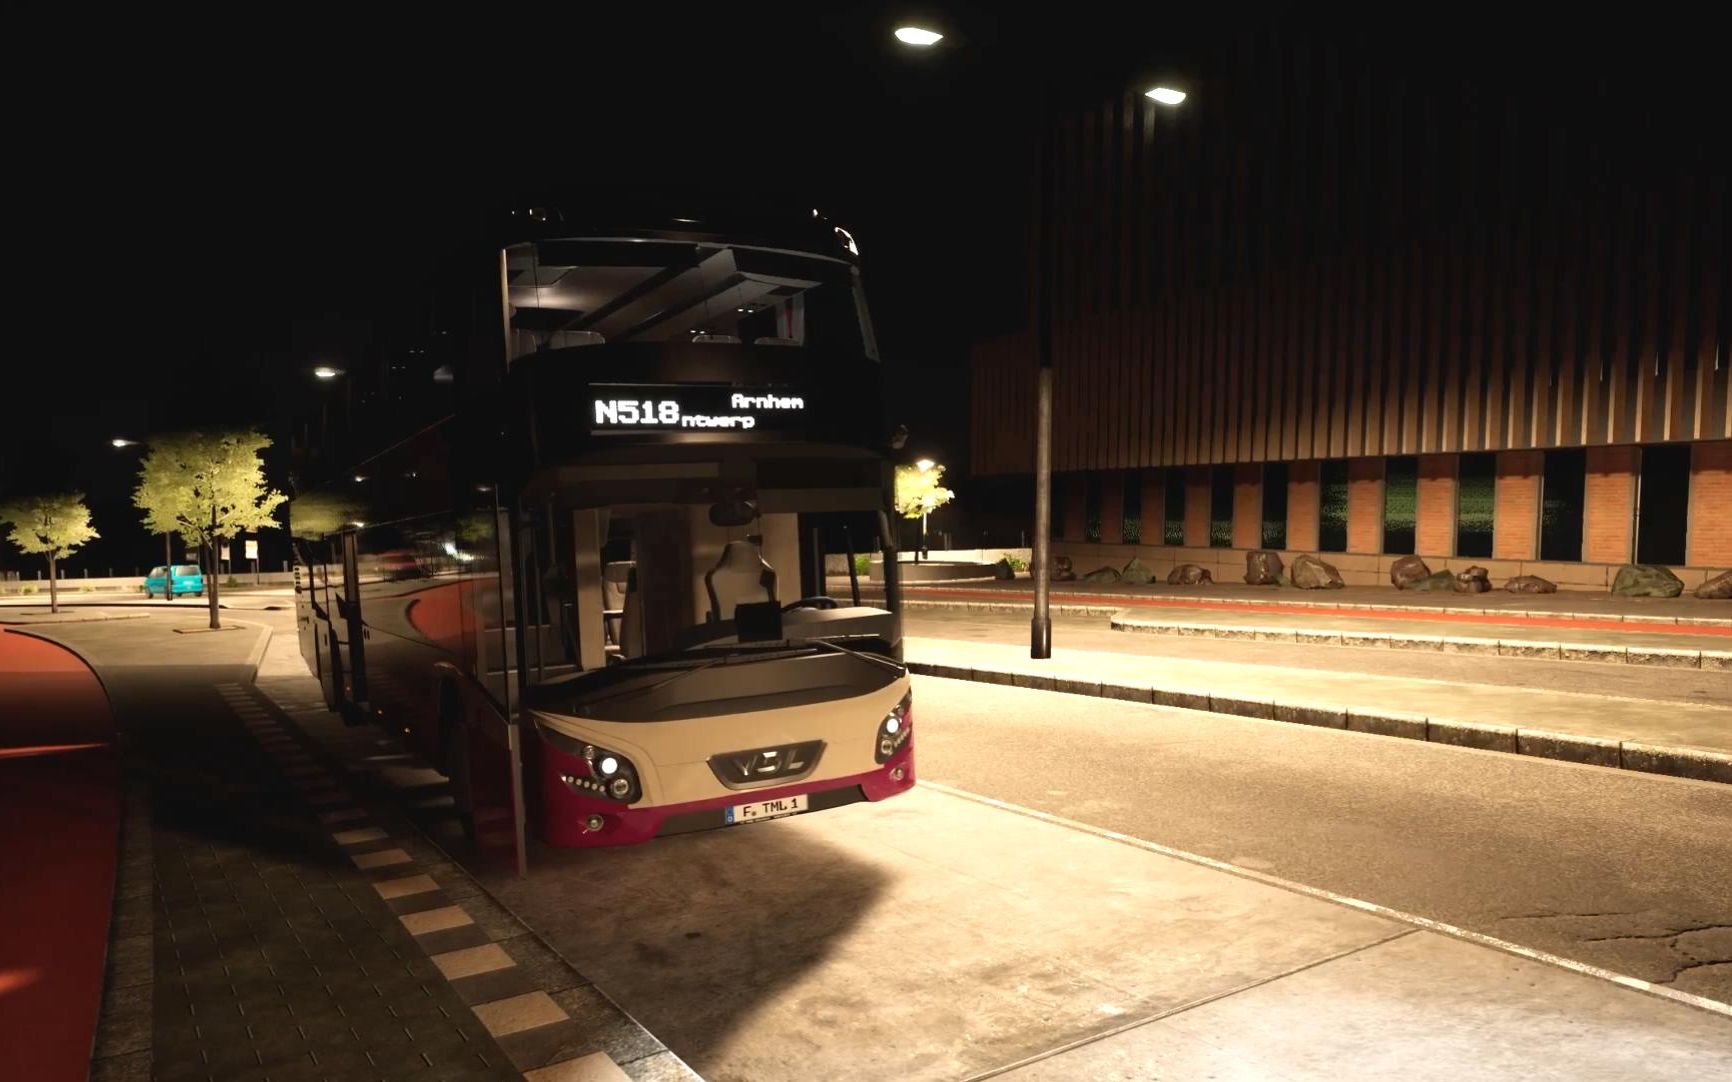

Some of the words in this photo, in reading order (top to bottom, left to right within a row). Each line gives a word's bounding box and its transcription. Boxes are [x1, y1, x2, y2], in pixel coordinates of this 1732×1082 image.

[731, 393, 804, 409] Arnhem
[595, 400, 679, 424] N518
[791, 798, 798, 809] 1
